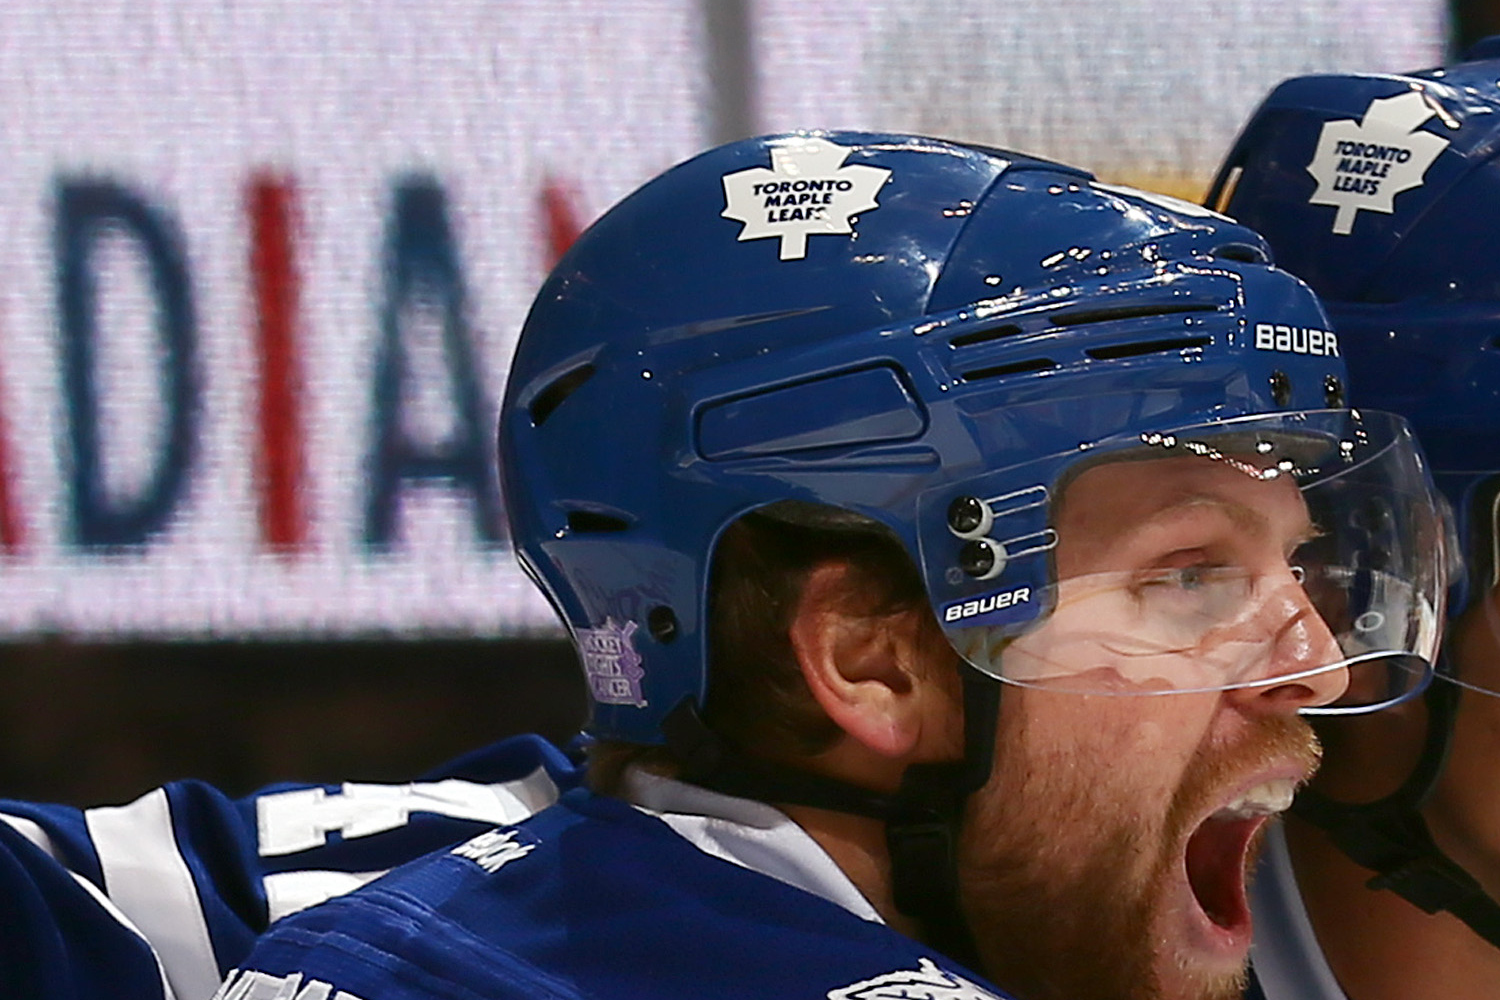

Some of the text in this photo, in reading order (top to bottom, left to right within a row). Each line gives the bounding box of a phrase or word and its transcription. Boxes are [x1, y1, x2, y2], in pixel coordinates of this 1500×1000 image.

[1334, 141, 1412, 164] TORONTO
[1336, 158, 1391, 178] MAPLE
[753, 180, 853, 196] TORONTO
[1333, 176, 1381, 196] LEAFS
[764, 192, 834, 208] MAPLE
[1255, 323, 1339, 357] BAUER
[0, 170, 592, 560] DIA
[945, 587, 1030, 622] BAUER
